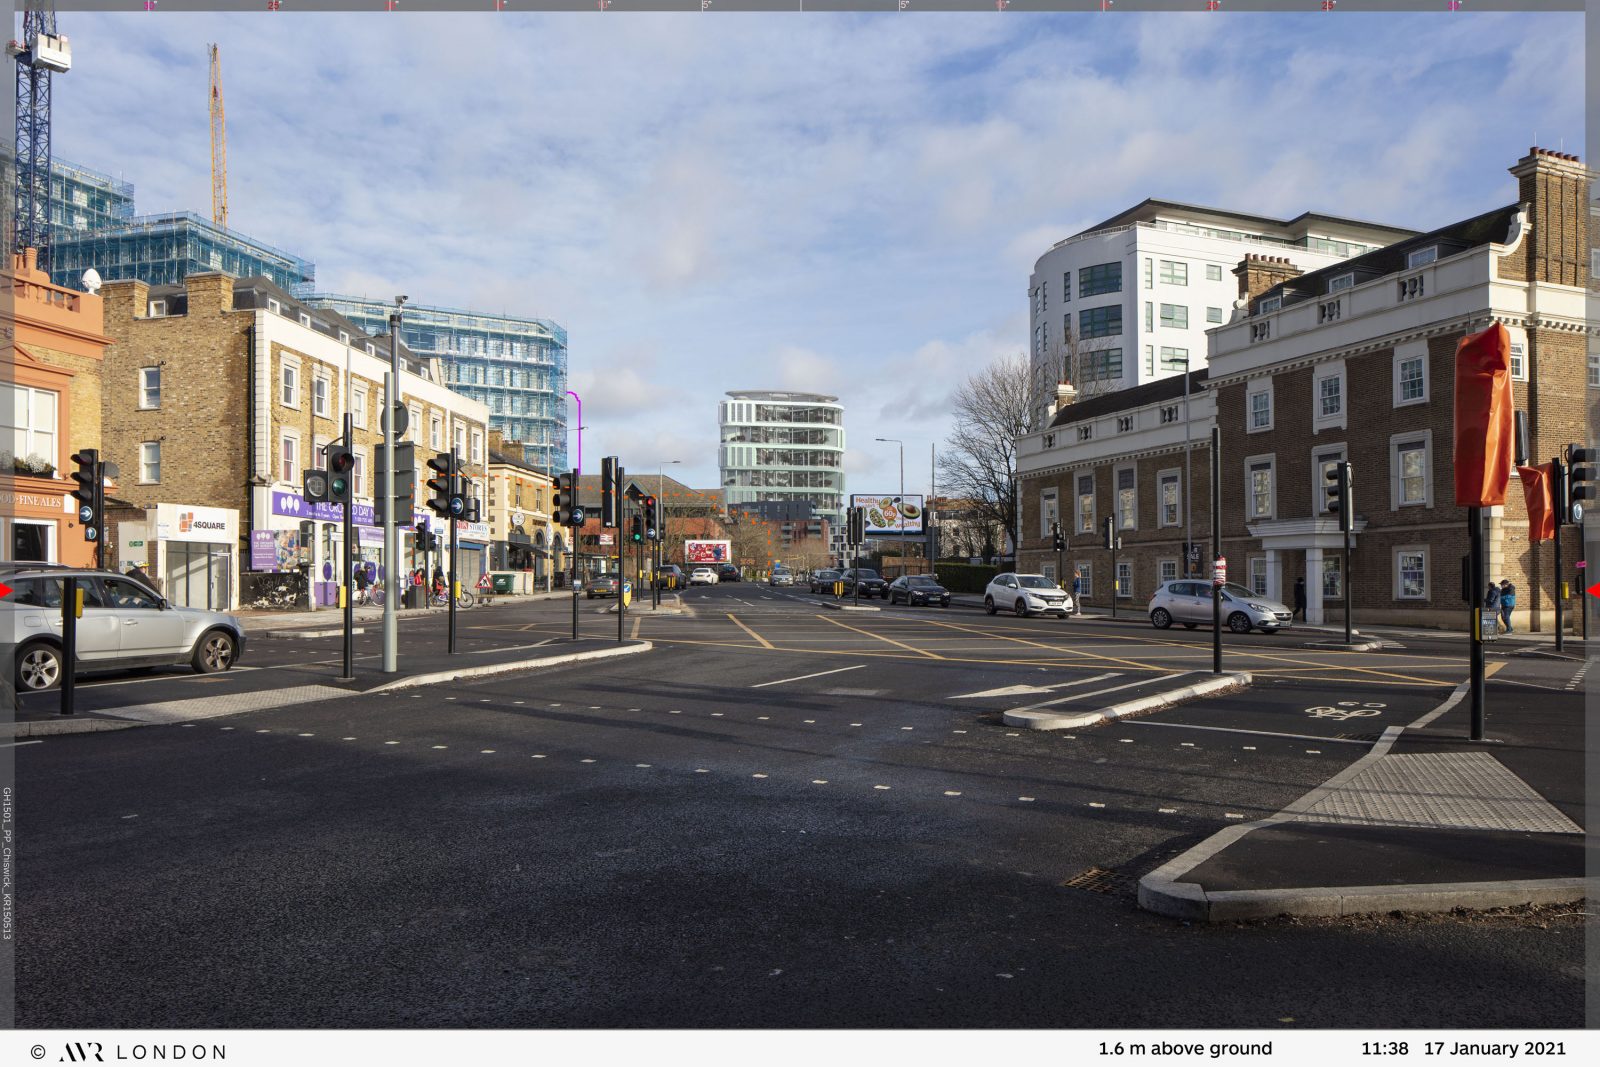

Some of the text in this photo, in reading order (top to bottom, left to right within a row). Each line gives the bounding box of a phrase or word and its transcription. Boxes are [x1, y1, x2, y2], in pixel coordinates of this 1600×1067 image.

[20, 495, 39, 506] FINE
[41, 497, 61, 507] ALES
[856, 497, 880, 506] Healthy
[193, 521, 226, 530] 4SQUARE
